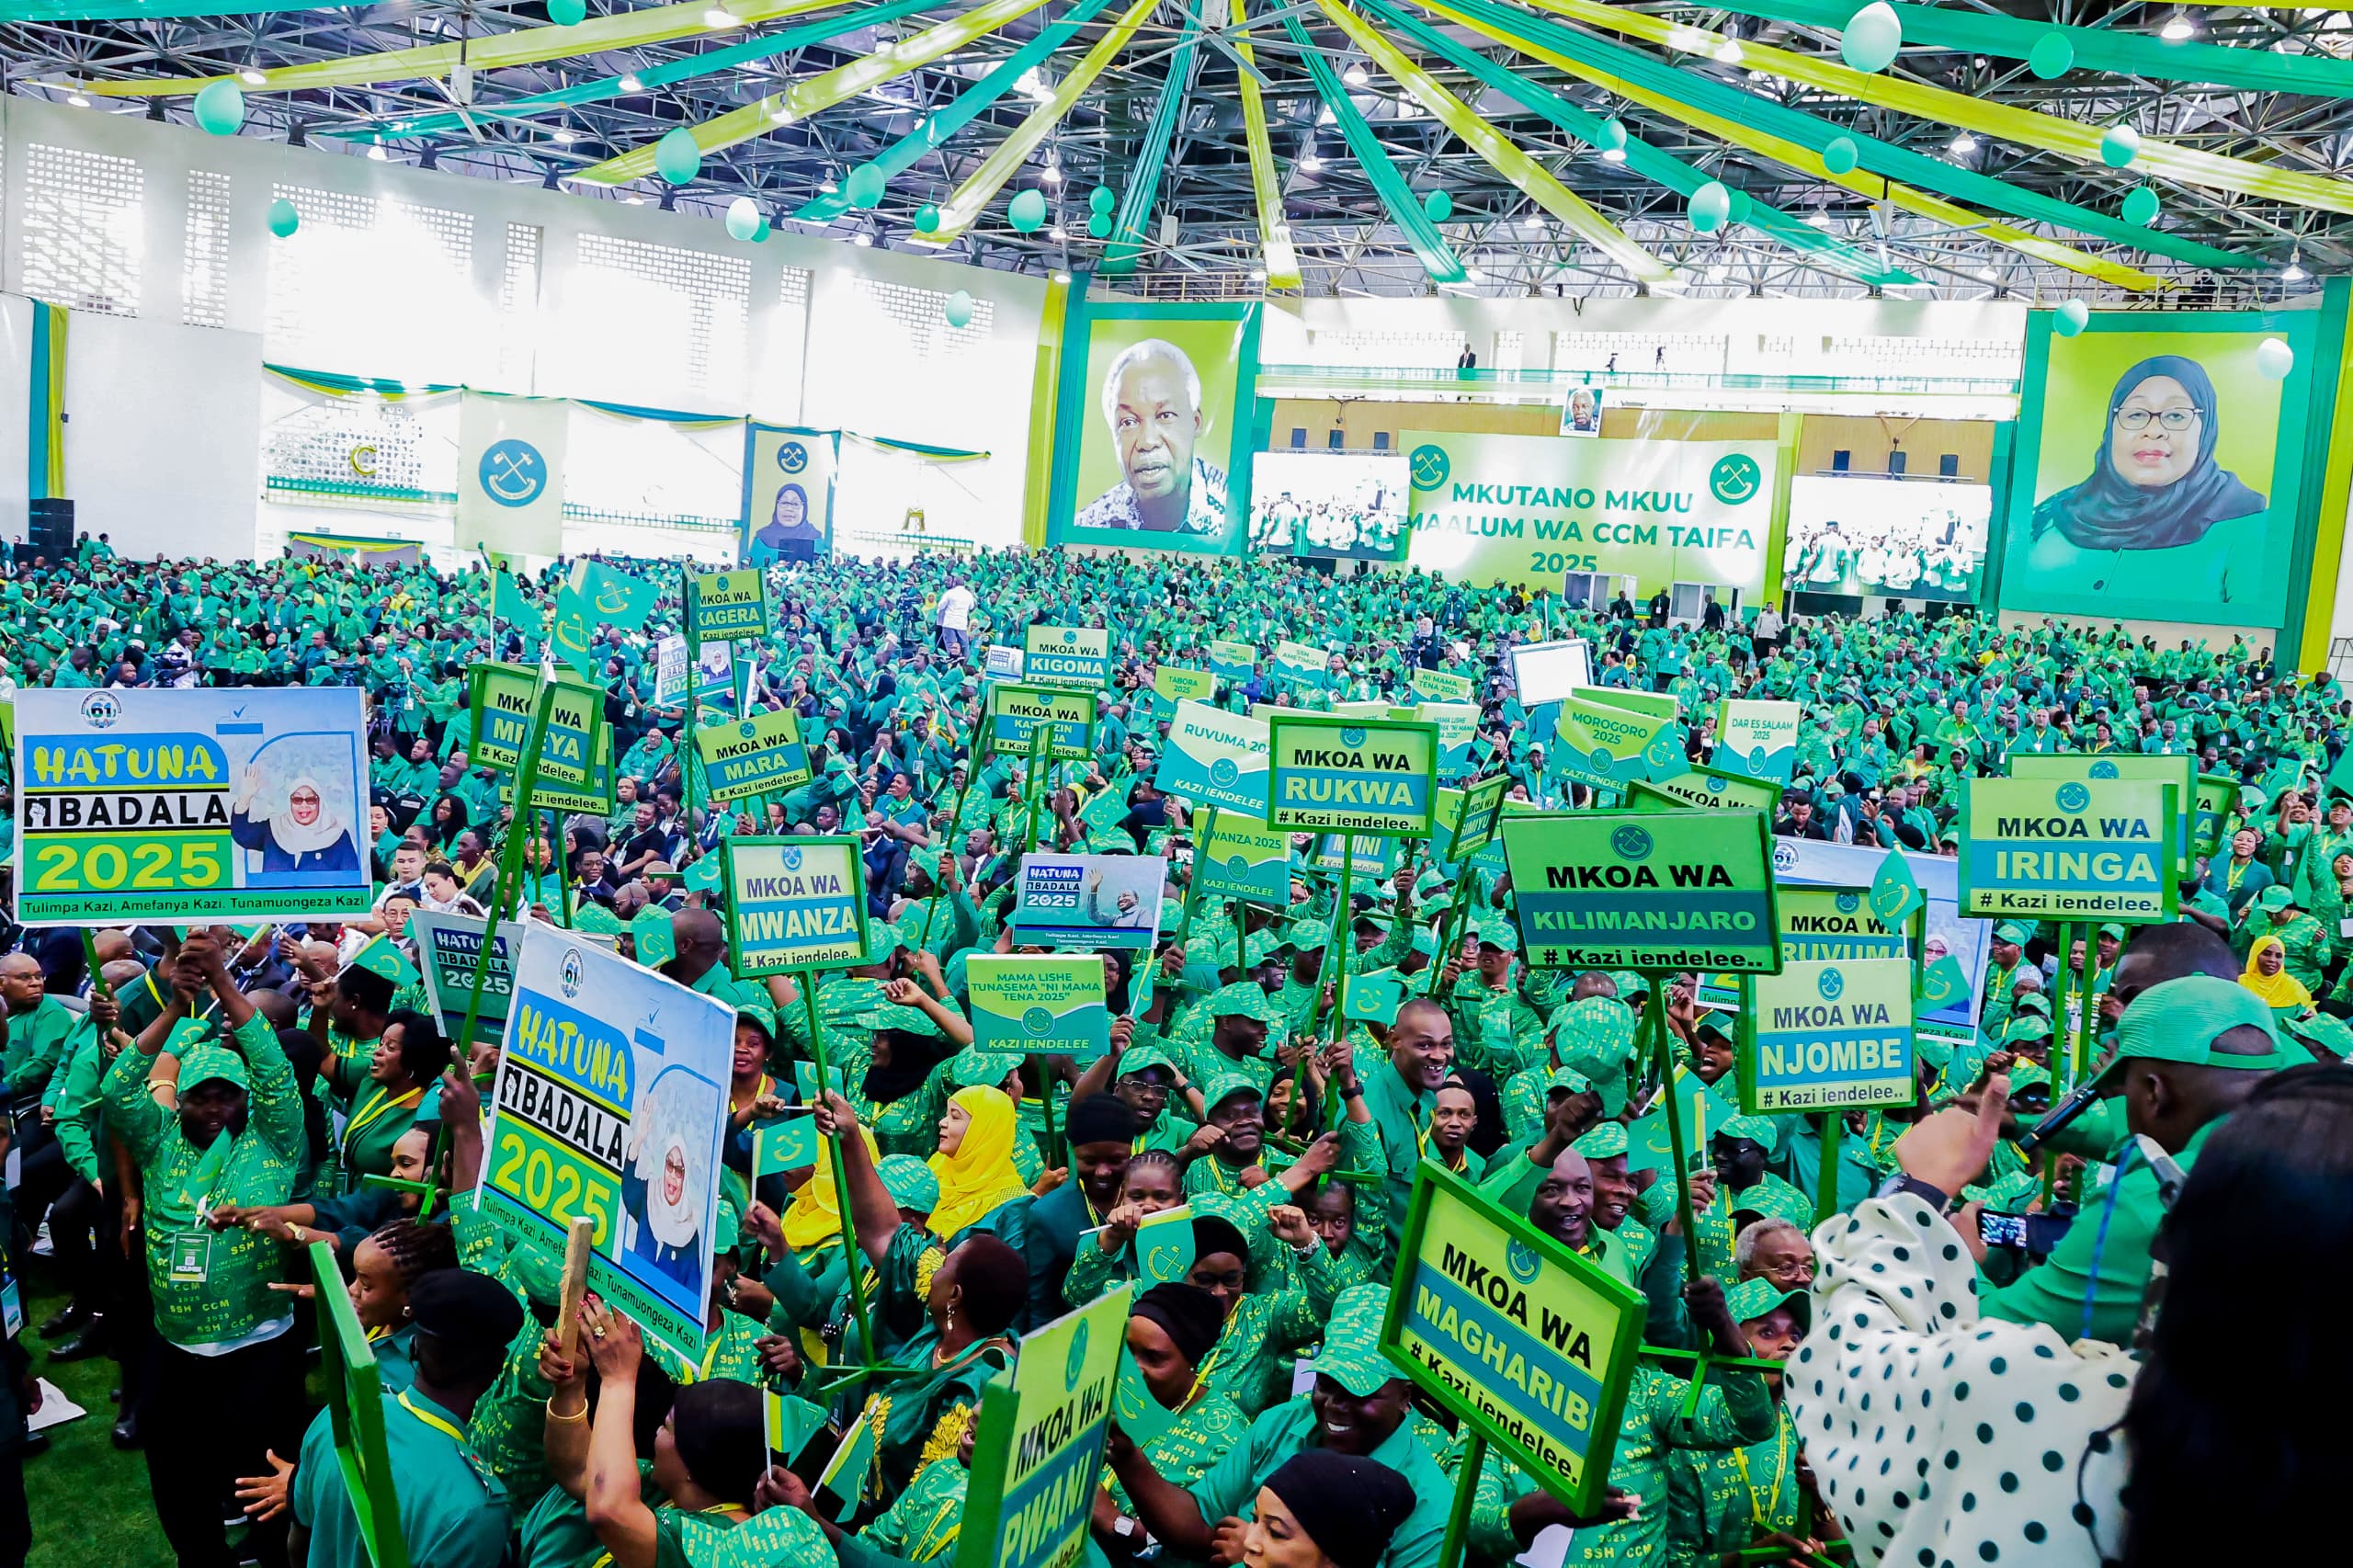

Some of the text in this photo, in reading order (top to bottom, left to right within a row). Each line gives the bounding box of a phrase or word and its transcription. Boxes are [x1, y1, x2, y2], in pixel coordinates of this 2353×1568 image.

[1453, 483, 1693, 513] MKUTANO MKUU
[1534, 519, 1583, 542] WA
[1593, 523, 1657, 546] CCM
[1667, 526, 1756, 551] TAIFA
[1530, 551, 1597, 574] 2025
[699, 591, 751, 606] MKOA WA
[699, 607, 760, 627] KAGERA
[1039, 643, 1099, 656] MKOA WA
[1030, 657, 1104, 676] KIGOMA
[1168, 676, 1198, 687] TABORA
[1173, 685, 1191, 694] 2025
[90, 701, 112, 718] 61
[555, 707, 582, 728] WA
[1010, 704, 1079, 722] MKOA WA
[1572, 710, 1648, 739] MOROGORO
[1732, 719, 1793, 730] DAR ES SALAAM
[493, 718, 581, 761] MYA
[1184, 723, 1246, 749] RUVUMA
[1592, 730, 1621, 745] 2025
[1752, 730, 1770, 740] 2025
[493, 747, 517, 765] Kaz
[716, 733, 789, 761] MKOA WA
[33, 744, 219, 783] HATUNA
[723, 752, 789, 781] MARA
[1294, 749, 1411, 770] MKOA WA
[729, 783, 752, 797] Kazi
[1285, 777, 1414, 806] RUKWA
[1585, 772, 1629, 792] IENDELE
[1174, 778, 1265, 810] KAZI IENDELEE
[1295, 812, 1331, 825] Kazi
[1337, 813, 1419, 831] iendelee..
[1997, 817, 2150, 838] MKOA WA
[1255, 836, 1281, 849] 2025
[36, 842, 221, 890] 2025
[1030, 868, 1080, 879] HATUNA
[1996, 851, 2157, 882] IRINGA
[746, 874, 842, 898] MKOA WA
[1547, 865, 1733, 889] MKOA WA
[1203, 878, 1274, 897] KAZI IENDELEE
[24, 902, 79, 915] Tulimpa
[121, 899, 189, 913] Amefanya
[230, 895, 332, 911] Tunamuongeza
[336, 894, 364, 907] Kazi
[1027, 893, 1076, 907] 2025
[2001, 893, 2047, 908] Kazi
[740, 905, 858, 942] MWANZA
[1533, 911, 1756, 931] KILIMANJARO
[1791, 915, 1859, 933] MKOA
[436, 931, 504, 955] HATUA
[1781, 942, 1904, 961] RUVUMA
[756, 952, 788, 968] Kazi
[1567, 949, 1625, 966] Kazi
[1631, 949, 1763, 967] iendelee..
[996, 972, 1073, 982] MAMA LISHE
[972, 983, 1037, 992] TUNASEMA
[1062, 983, 1101, 992] MAMA
[1002, 993, 1034, 1001] TENA
[1703, 993, 1740, 1005] Tulimp
[1774, 1003, 1890, 1028] MKOA WA
[518, 1003, 629, 1102] HATUNA
[988, 1039, 1090, 1049] KAZI IENDELEE
[1760, 1038, 1902, 1077] NJOMBE
[1779, 1088, 1816, 1106] Kazi
[1822, 1085, 1904, 1105] iendelee..
[494, 1132, 612, 1246] 2025
[231, 1241, 255, 1256] SSH
[483, 1196, 516, 1227] Tulimpa
[539, 1231, 566, 1259] Amefa
[607, 1273, 674, 1335] Tunamuongeza
[676, 1323, 698, 1351] Kazi
[1441, 1242, 1592, 1370] MKOA WA
[1427, 1352, 1472, 1403] Kazi
[1014, 1376, 1105, 1483] MKOA WA
[1155, 1449, 1179, 1466] SSH
[1711, 1487, 1739, 1501] SSH
[997, 1449, 1093, 1568] PWANI
[1584, 1547, 1615, 1559] SSH
